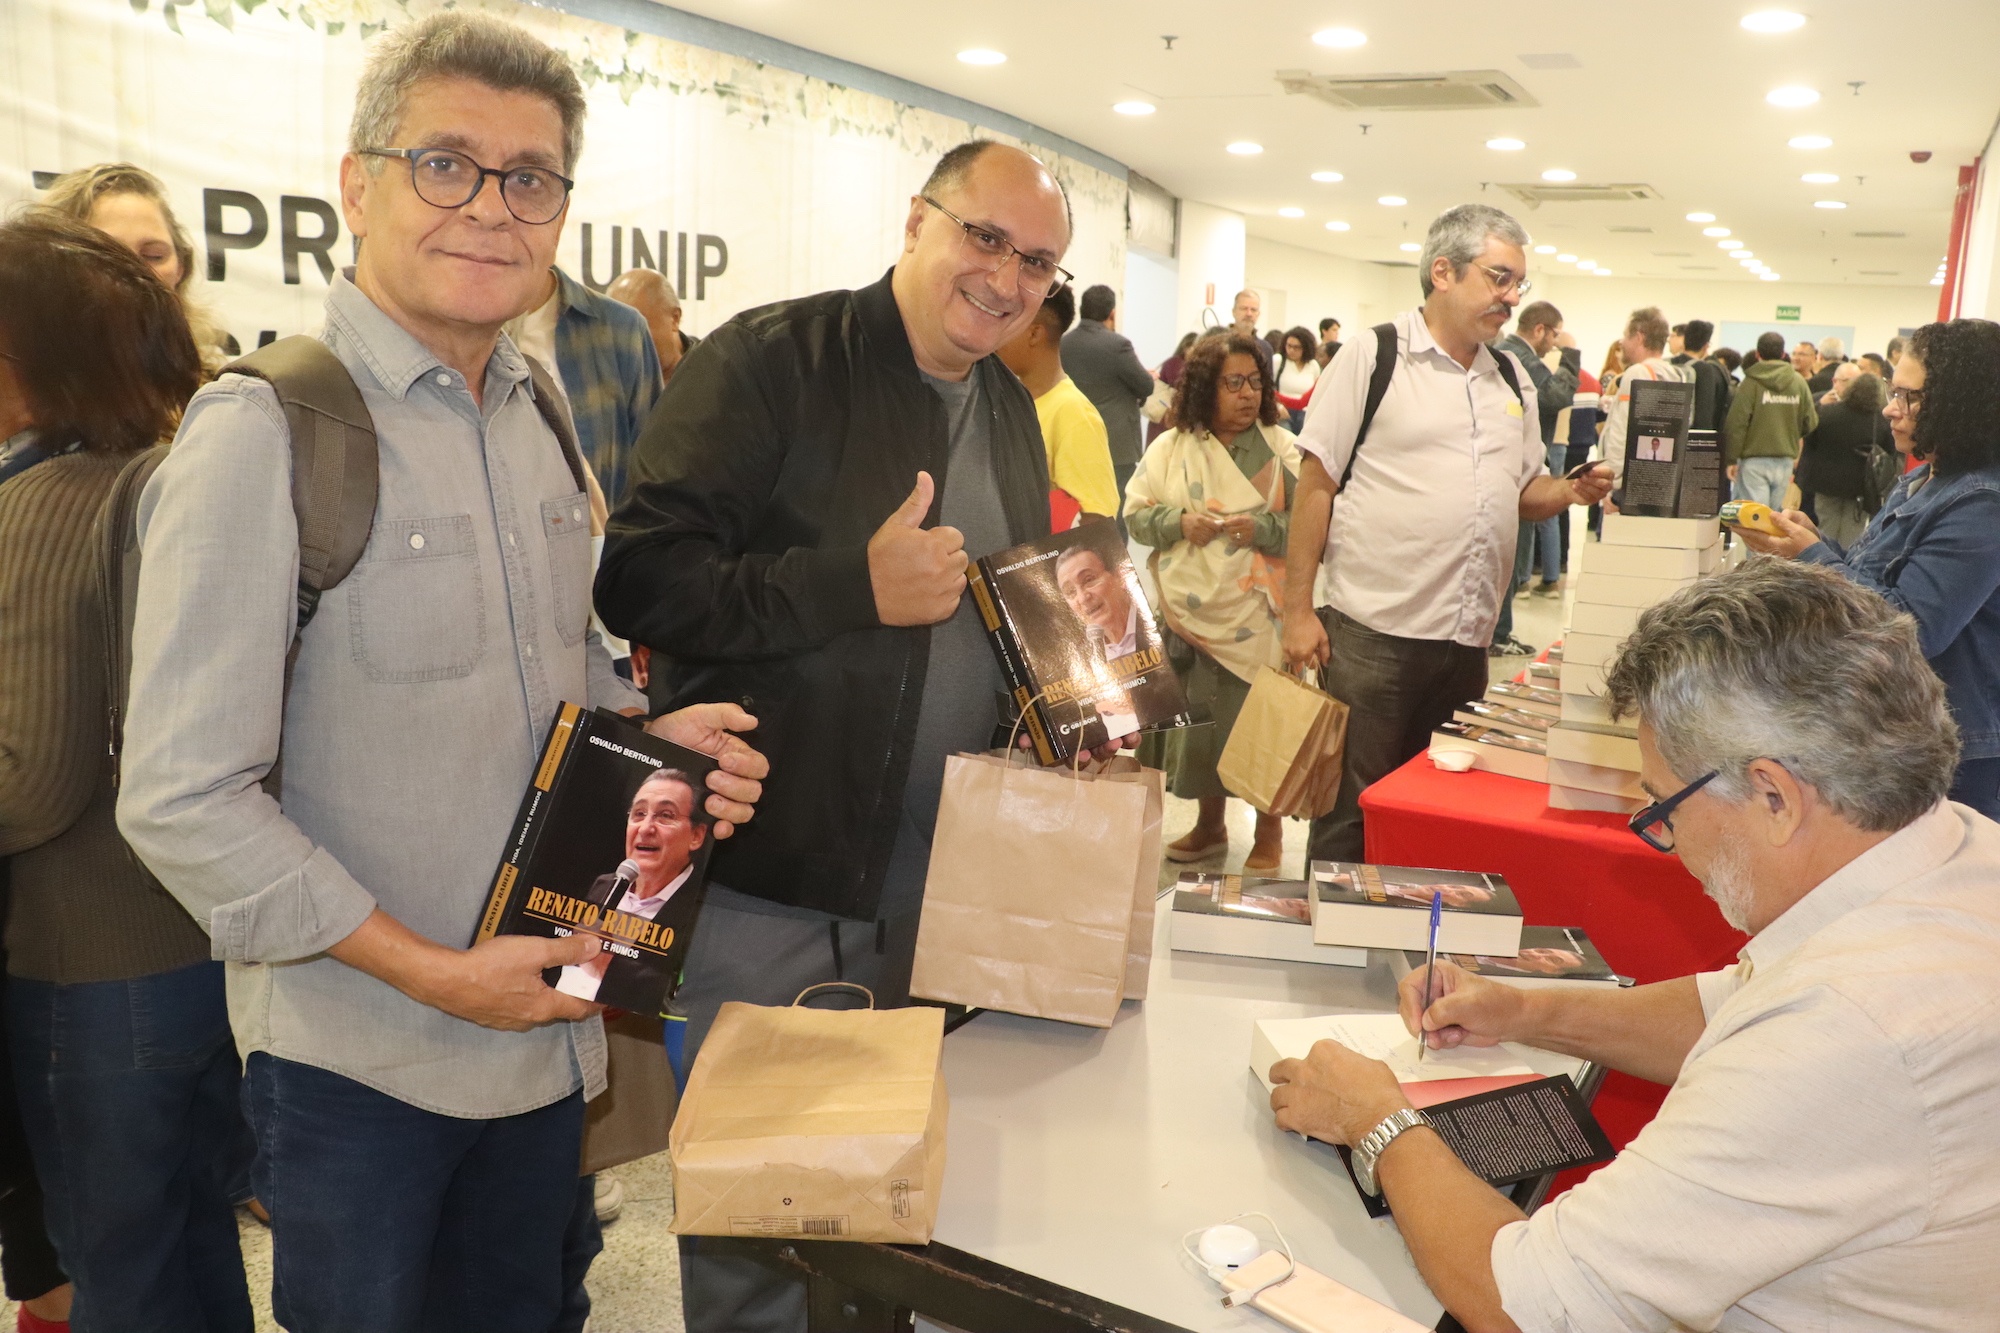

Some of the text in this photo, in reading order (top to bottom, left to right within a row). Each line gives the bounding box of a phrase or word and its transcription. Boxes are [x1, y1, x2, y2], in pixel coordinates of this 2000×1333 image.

[581, 222, 728, 301] UNIP
[996, 549, 1060, 576] OSVALDO BERTOLINO
[1124, 676, 1147, 690] RUMOS
[589, 735, 663, 768] OSVALDO BERTOLINO
[518, 822, 530, 846] IDEIAS
[529, 790, 542, 817] RUMOS
[485, 866, 513, 932] RENATO RABELO
[525, 886, 675, 950] RENATO RABELO
[603, 941, 610, 950] E
[609, 942, 640, 960] RUMOS
